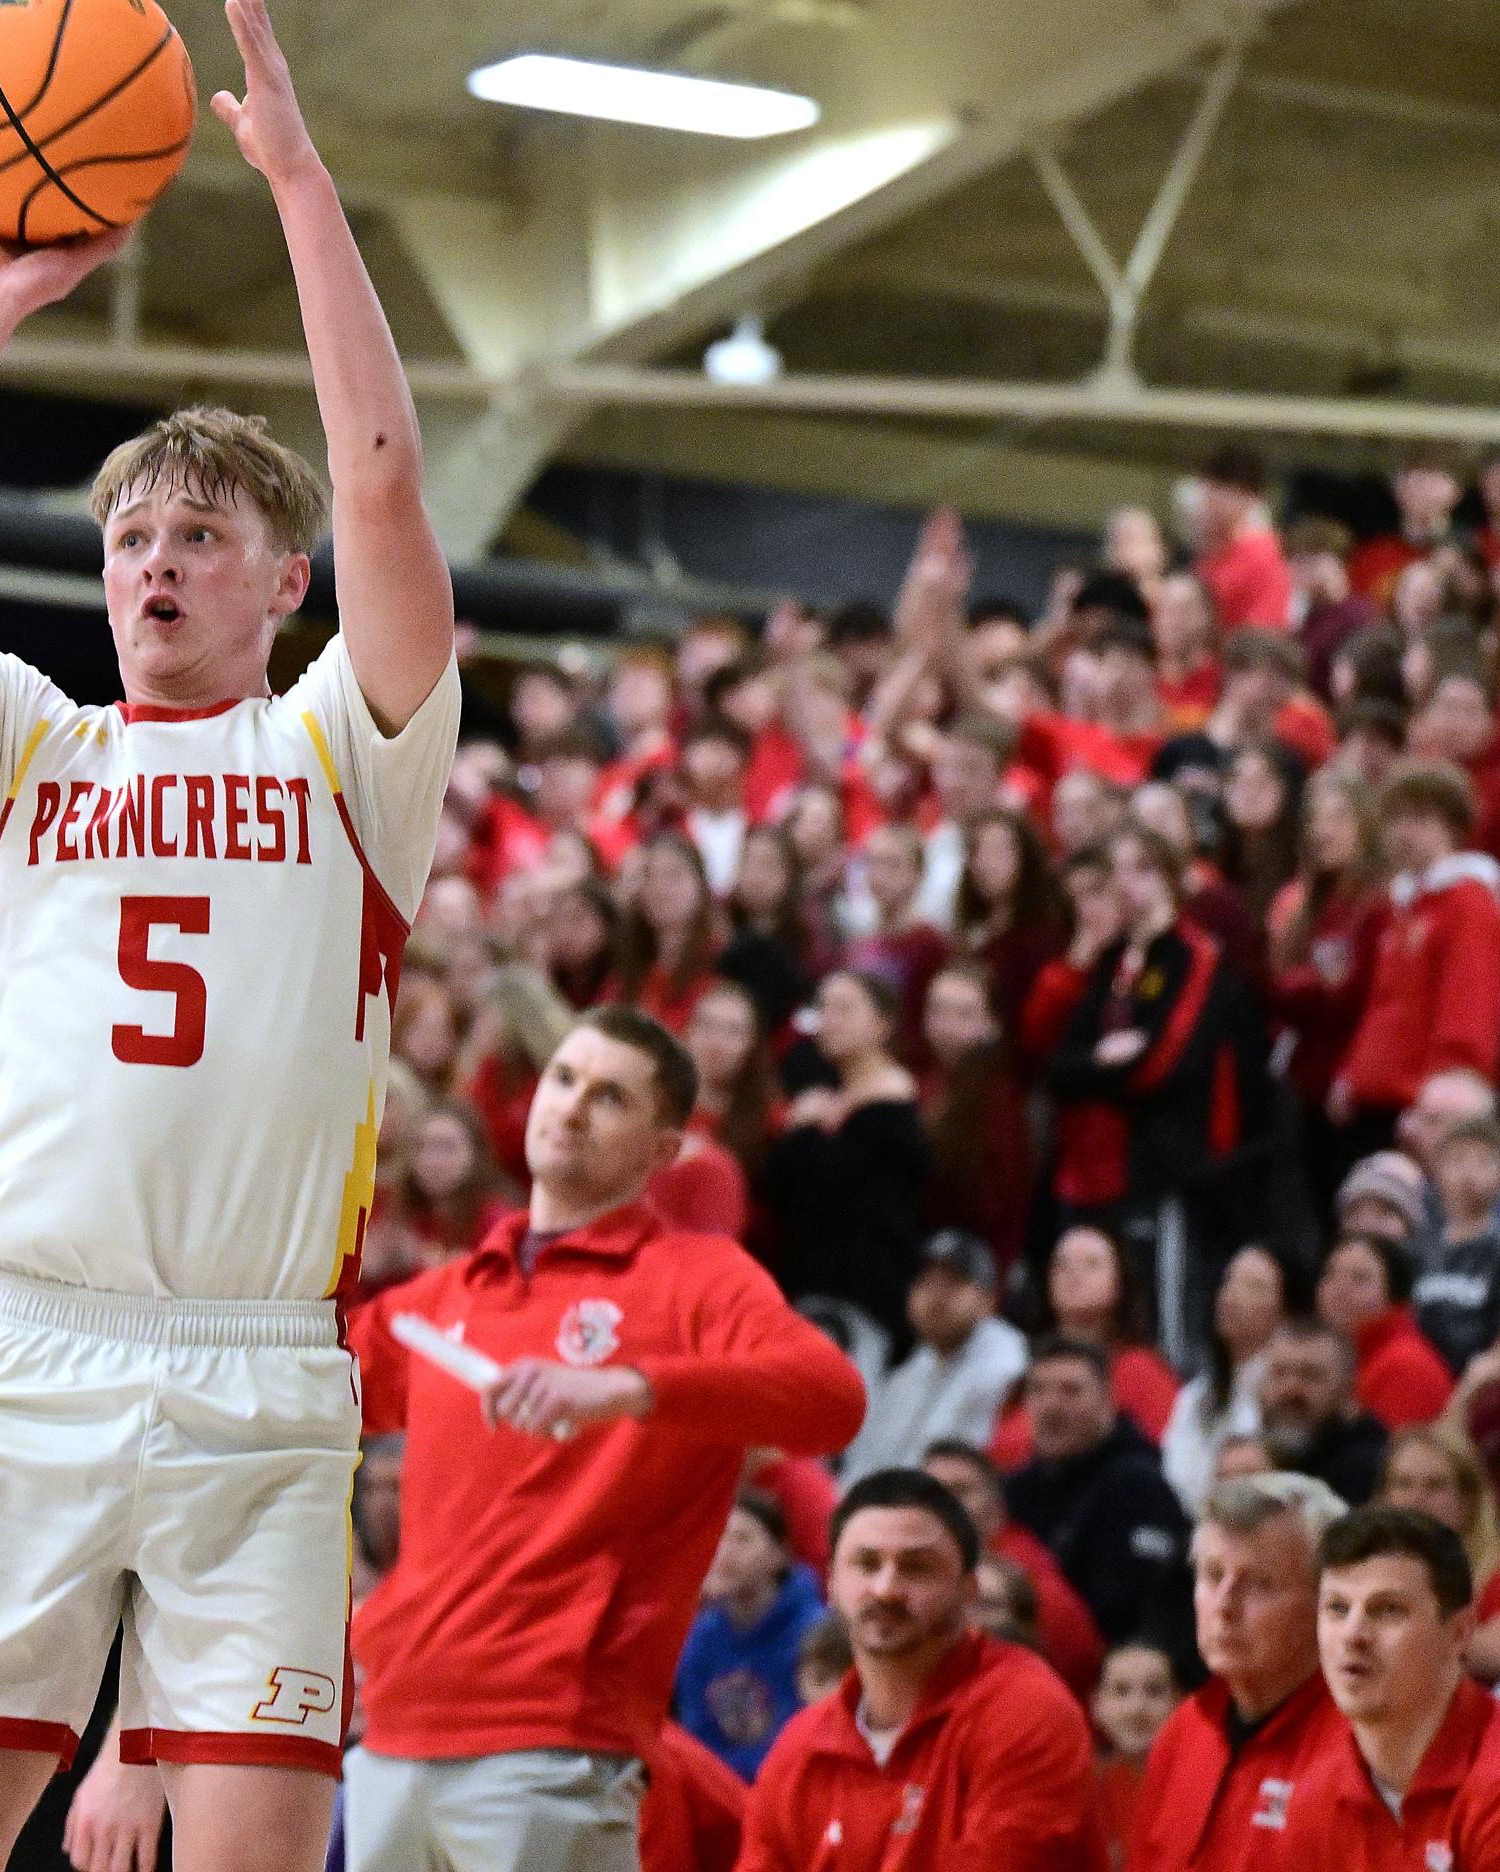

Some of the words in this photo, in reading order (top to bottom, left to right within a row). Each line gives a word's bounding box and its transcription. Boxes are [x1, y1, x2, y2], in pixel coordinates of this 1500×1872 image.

[27, 773, 313, 867] PENNCREST
[111, 896, 211, 1067] 5
[248, 1667, 335, 1724] P
